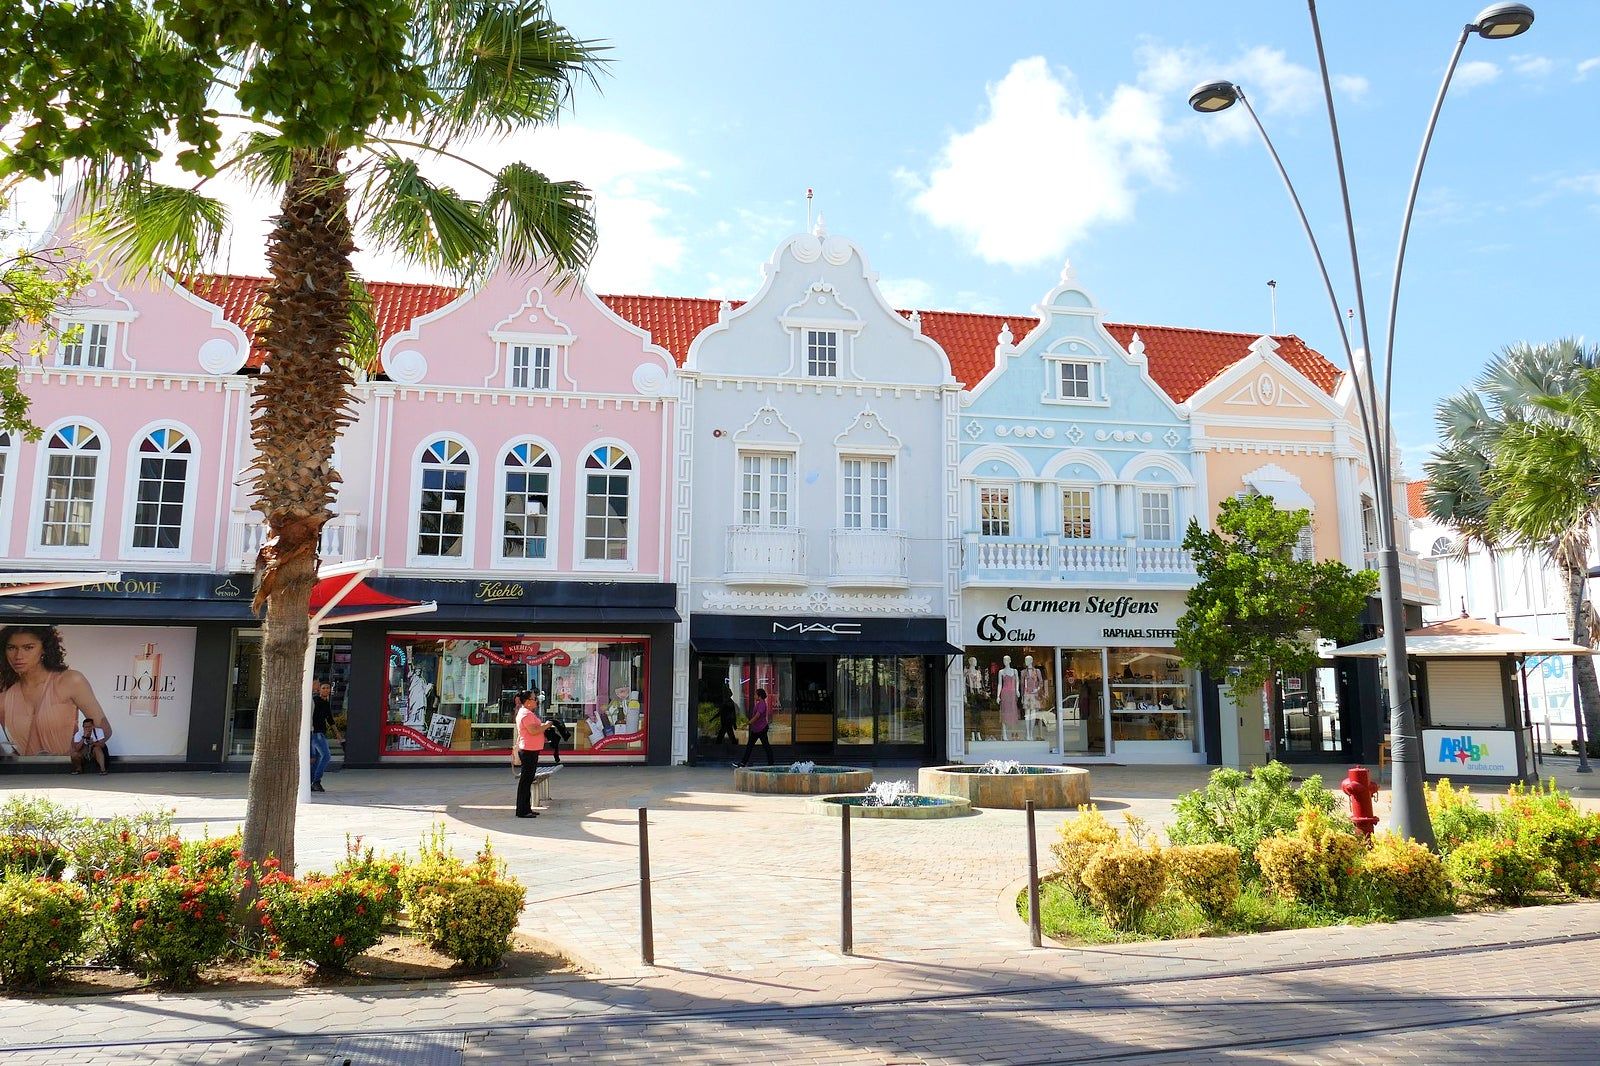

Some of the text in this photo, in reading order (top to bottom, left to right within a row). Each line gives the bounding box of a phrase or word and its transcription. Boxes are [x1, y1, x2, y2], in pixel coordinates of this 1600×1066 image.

[475, 581, 524, 599] Kiehl's
[1007, 594, 1159, 618] Carmen Steffens
[976, 613, 1036, 643] CS Club
[1103, 628, 1179, 639] RAPHAEL STEFFE
[114, 670, 176, 692] IDÔLE
[1439, 736, 1489, 763] ARUBA
[1467, 763, 1505, 771] aruba.com
